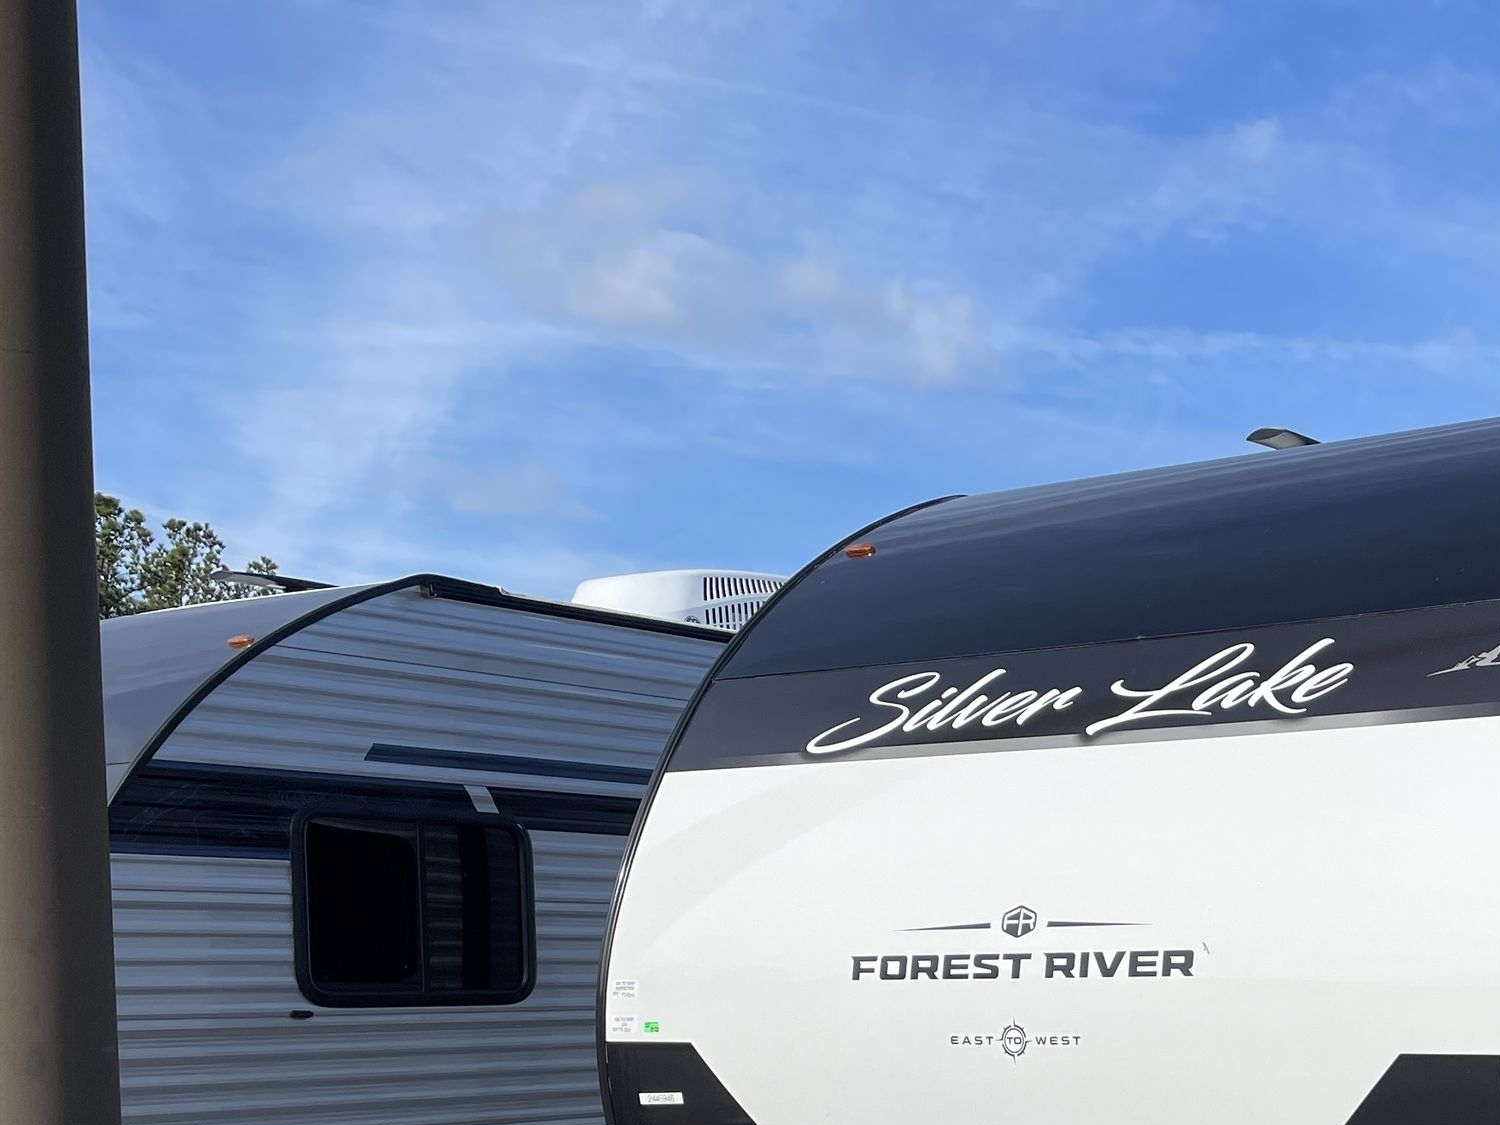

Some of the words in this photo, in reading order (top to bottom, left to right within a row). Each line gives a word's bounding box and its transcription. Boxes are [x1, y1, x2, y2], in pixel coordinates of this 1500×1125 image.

[806, 668, 1083, 754] Silver
[1085, 637, 1354, 735] Lake
[851, 953, 1032, 981] FOREST
[1043, 950, 1195, 979] RIVER
[950, 1036, 994, 1046] EAST
[1006, 1036, 1023, 1045] TO
[1035, 1036, 1081, 1046] WEST
